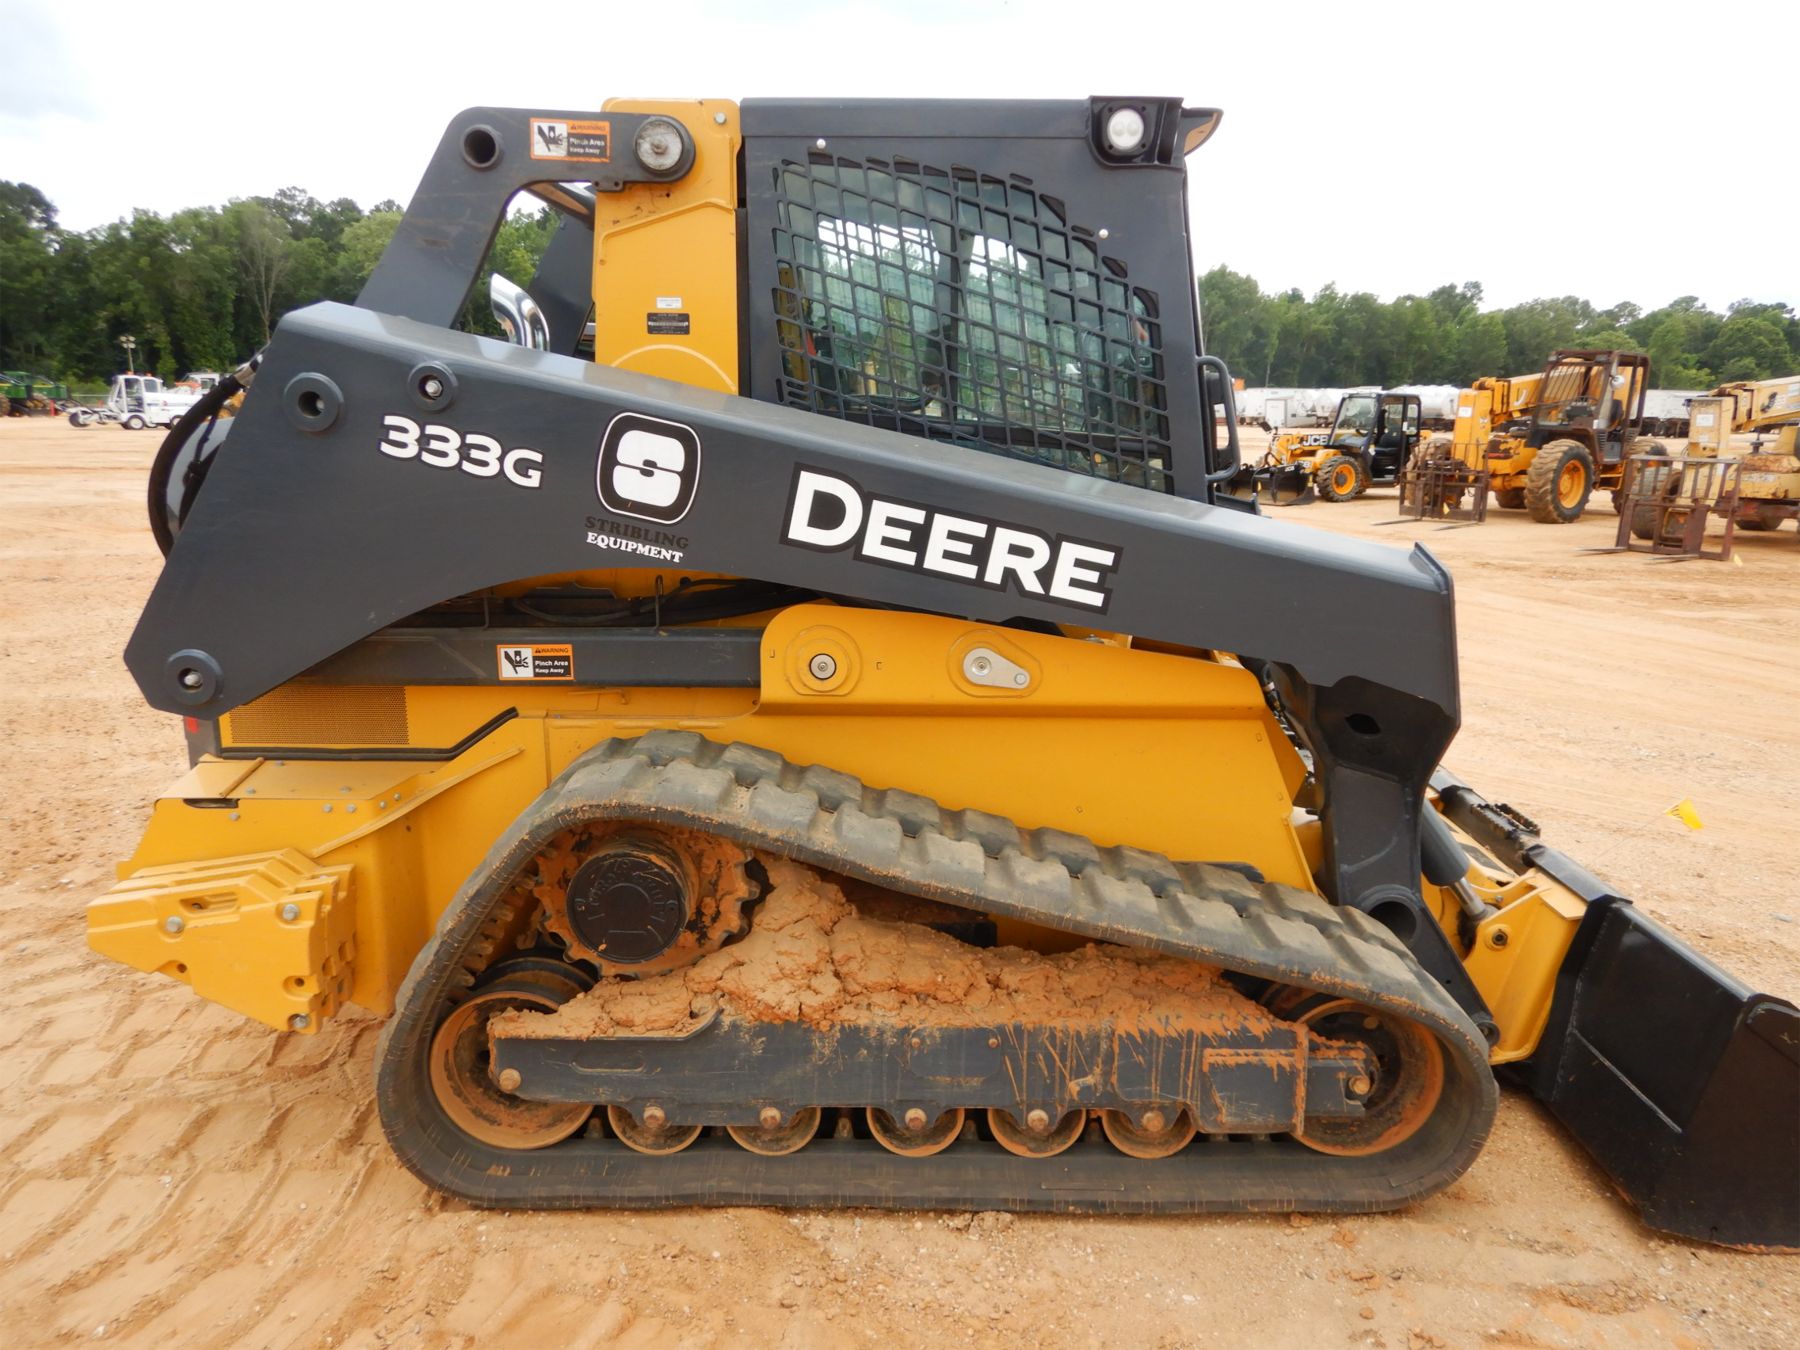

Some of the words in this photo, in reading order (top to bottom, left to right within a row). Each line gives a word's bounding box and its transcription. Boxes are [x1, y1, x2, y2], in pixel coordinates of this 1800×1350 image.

[589, 138, 605, 146] Area
[379, 415, 544, 488] 333G
[1303, 434, 1328, 446] JCB
[585, 516, 690, 550] STRIBLING
[586, 532, 683, 563] EQUIPMENT
[787, 470, 1115, 608] DEERE
